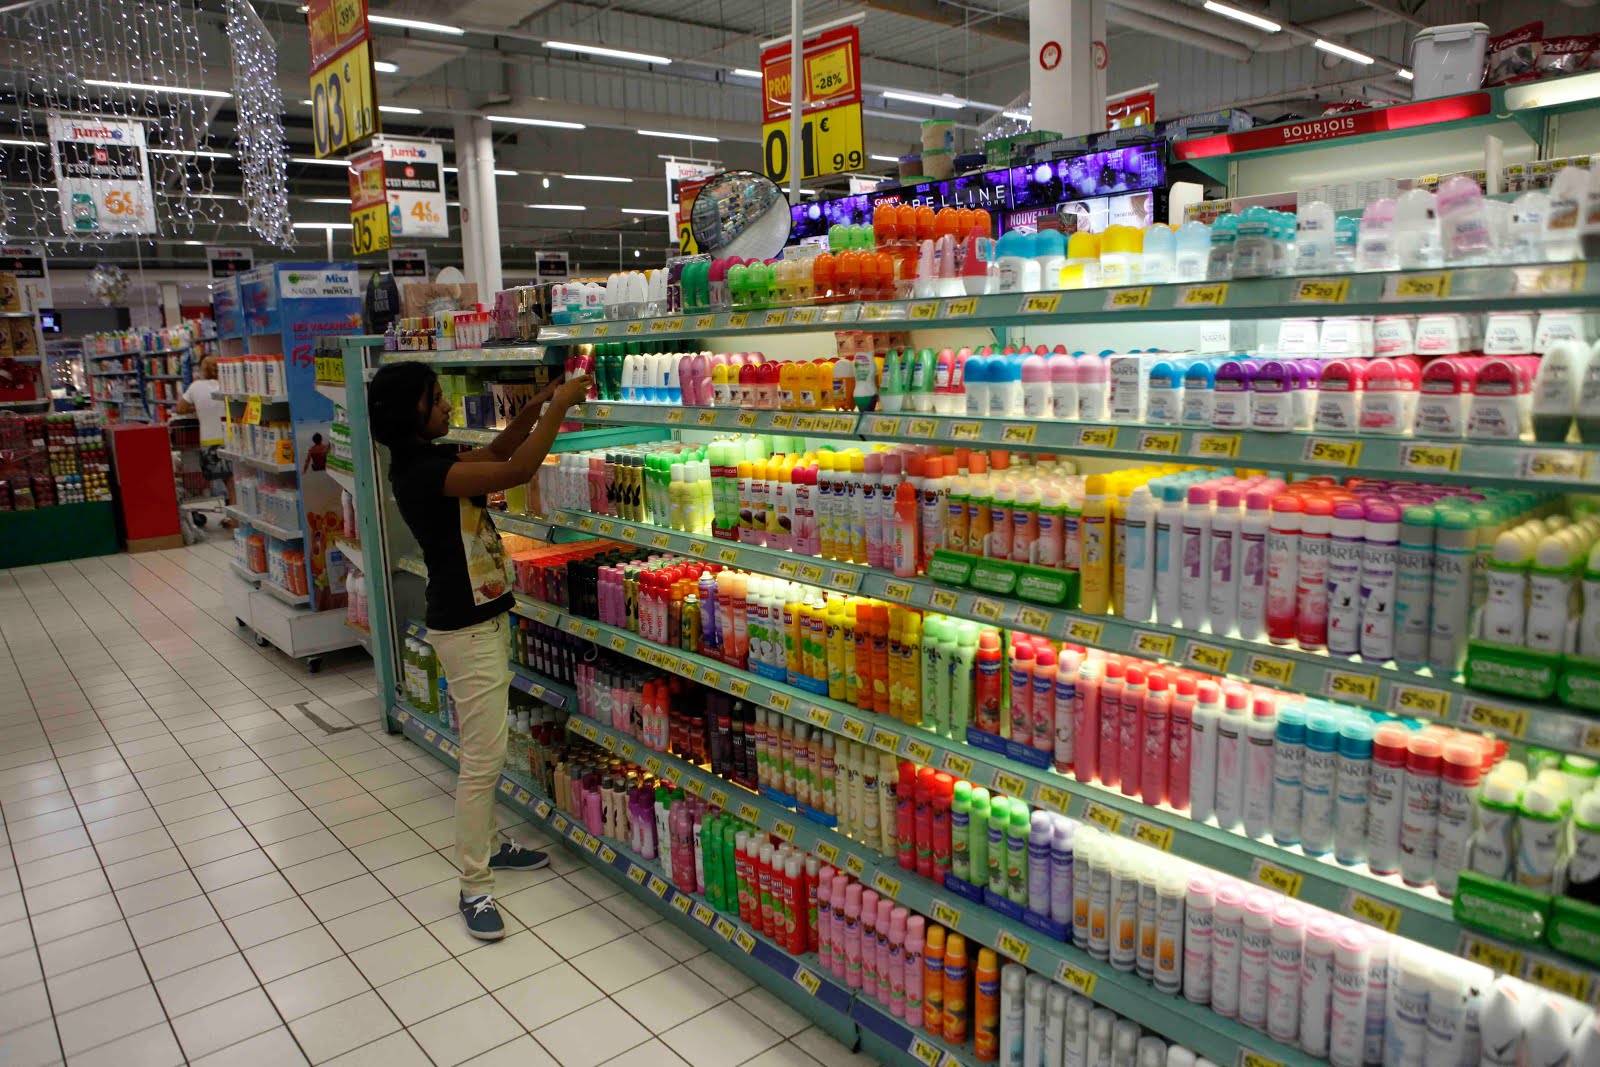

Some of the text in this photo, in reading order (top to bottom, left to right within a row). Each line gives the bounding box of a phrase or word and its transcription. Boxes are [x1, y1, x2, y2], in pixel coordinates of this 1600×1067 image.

[816, 71, 842, 90] -28%
[72, 126, 123, 140] jumbo
[1283, 118, 1355, 138] BOURJOIS
[391, 147, 427, 160] jumbo
[980, 199, 1006, 208] YORK
[326, 274, 349, 284] Mixa
[291, 287, 319, 296] NARTA
[322, 288, 353, 296] PROVOST
[1300, 284, 1332, 297] 5€20
[1111, 366, 1138, 375] NARTA
[1143, 436, 1170, 448] 5€20
[1312, 443, 1345, 458] 5€20
[1252, 661, 1281, 675] 5€20
[1400, 691, 1436, 708] 5€20
